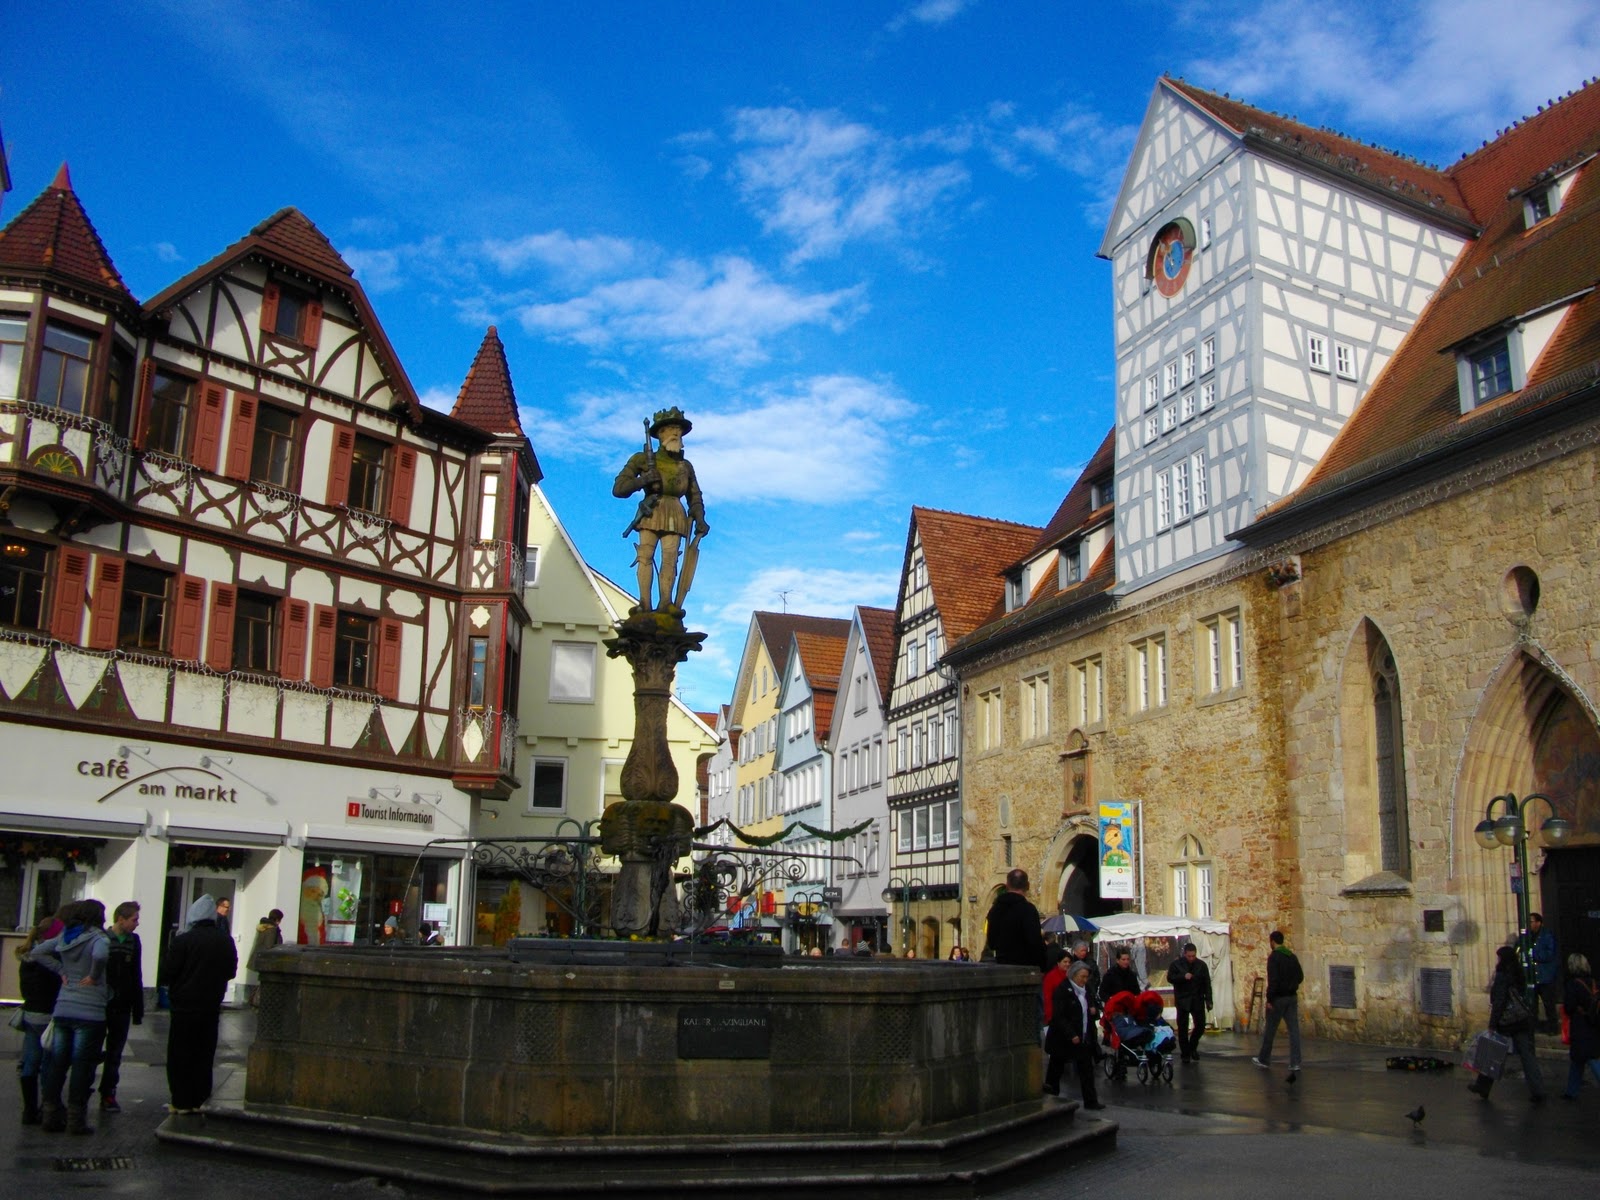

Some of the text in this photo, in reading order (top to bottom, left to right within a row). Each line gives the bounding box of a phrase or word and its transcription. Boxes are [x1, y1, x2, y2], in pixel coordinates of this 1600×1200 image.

[77, 758, 130, 779] café
[138, 783, 239, 804] am markt
[361, 803, 387, 821] Tourist
[388, 806, 433, 824] Information
[683, 1017, 712, 1026] KAIR
[714, 1018, 760, 1027] AXIMILIAN
